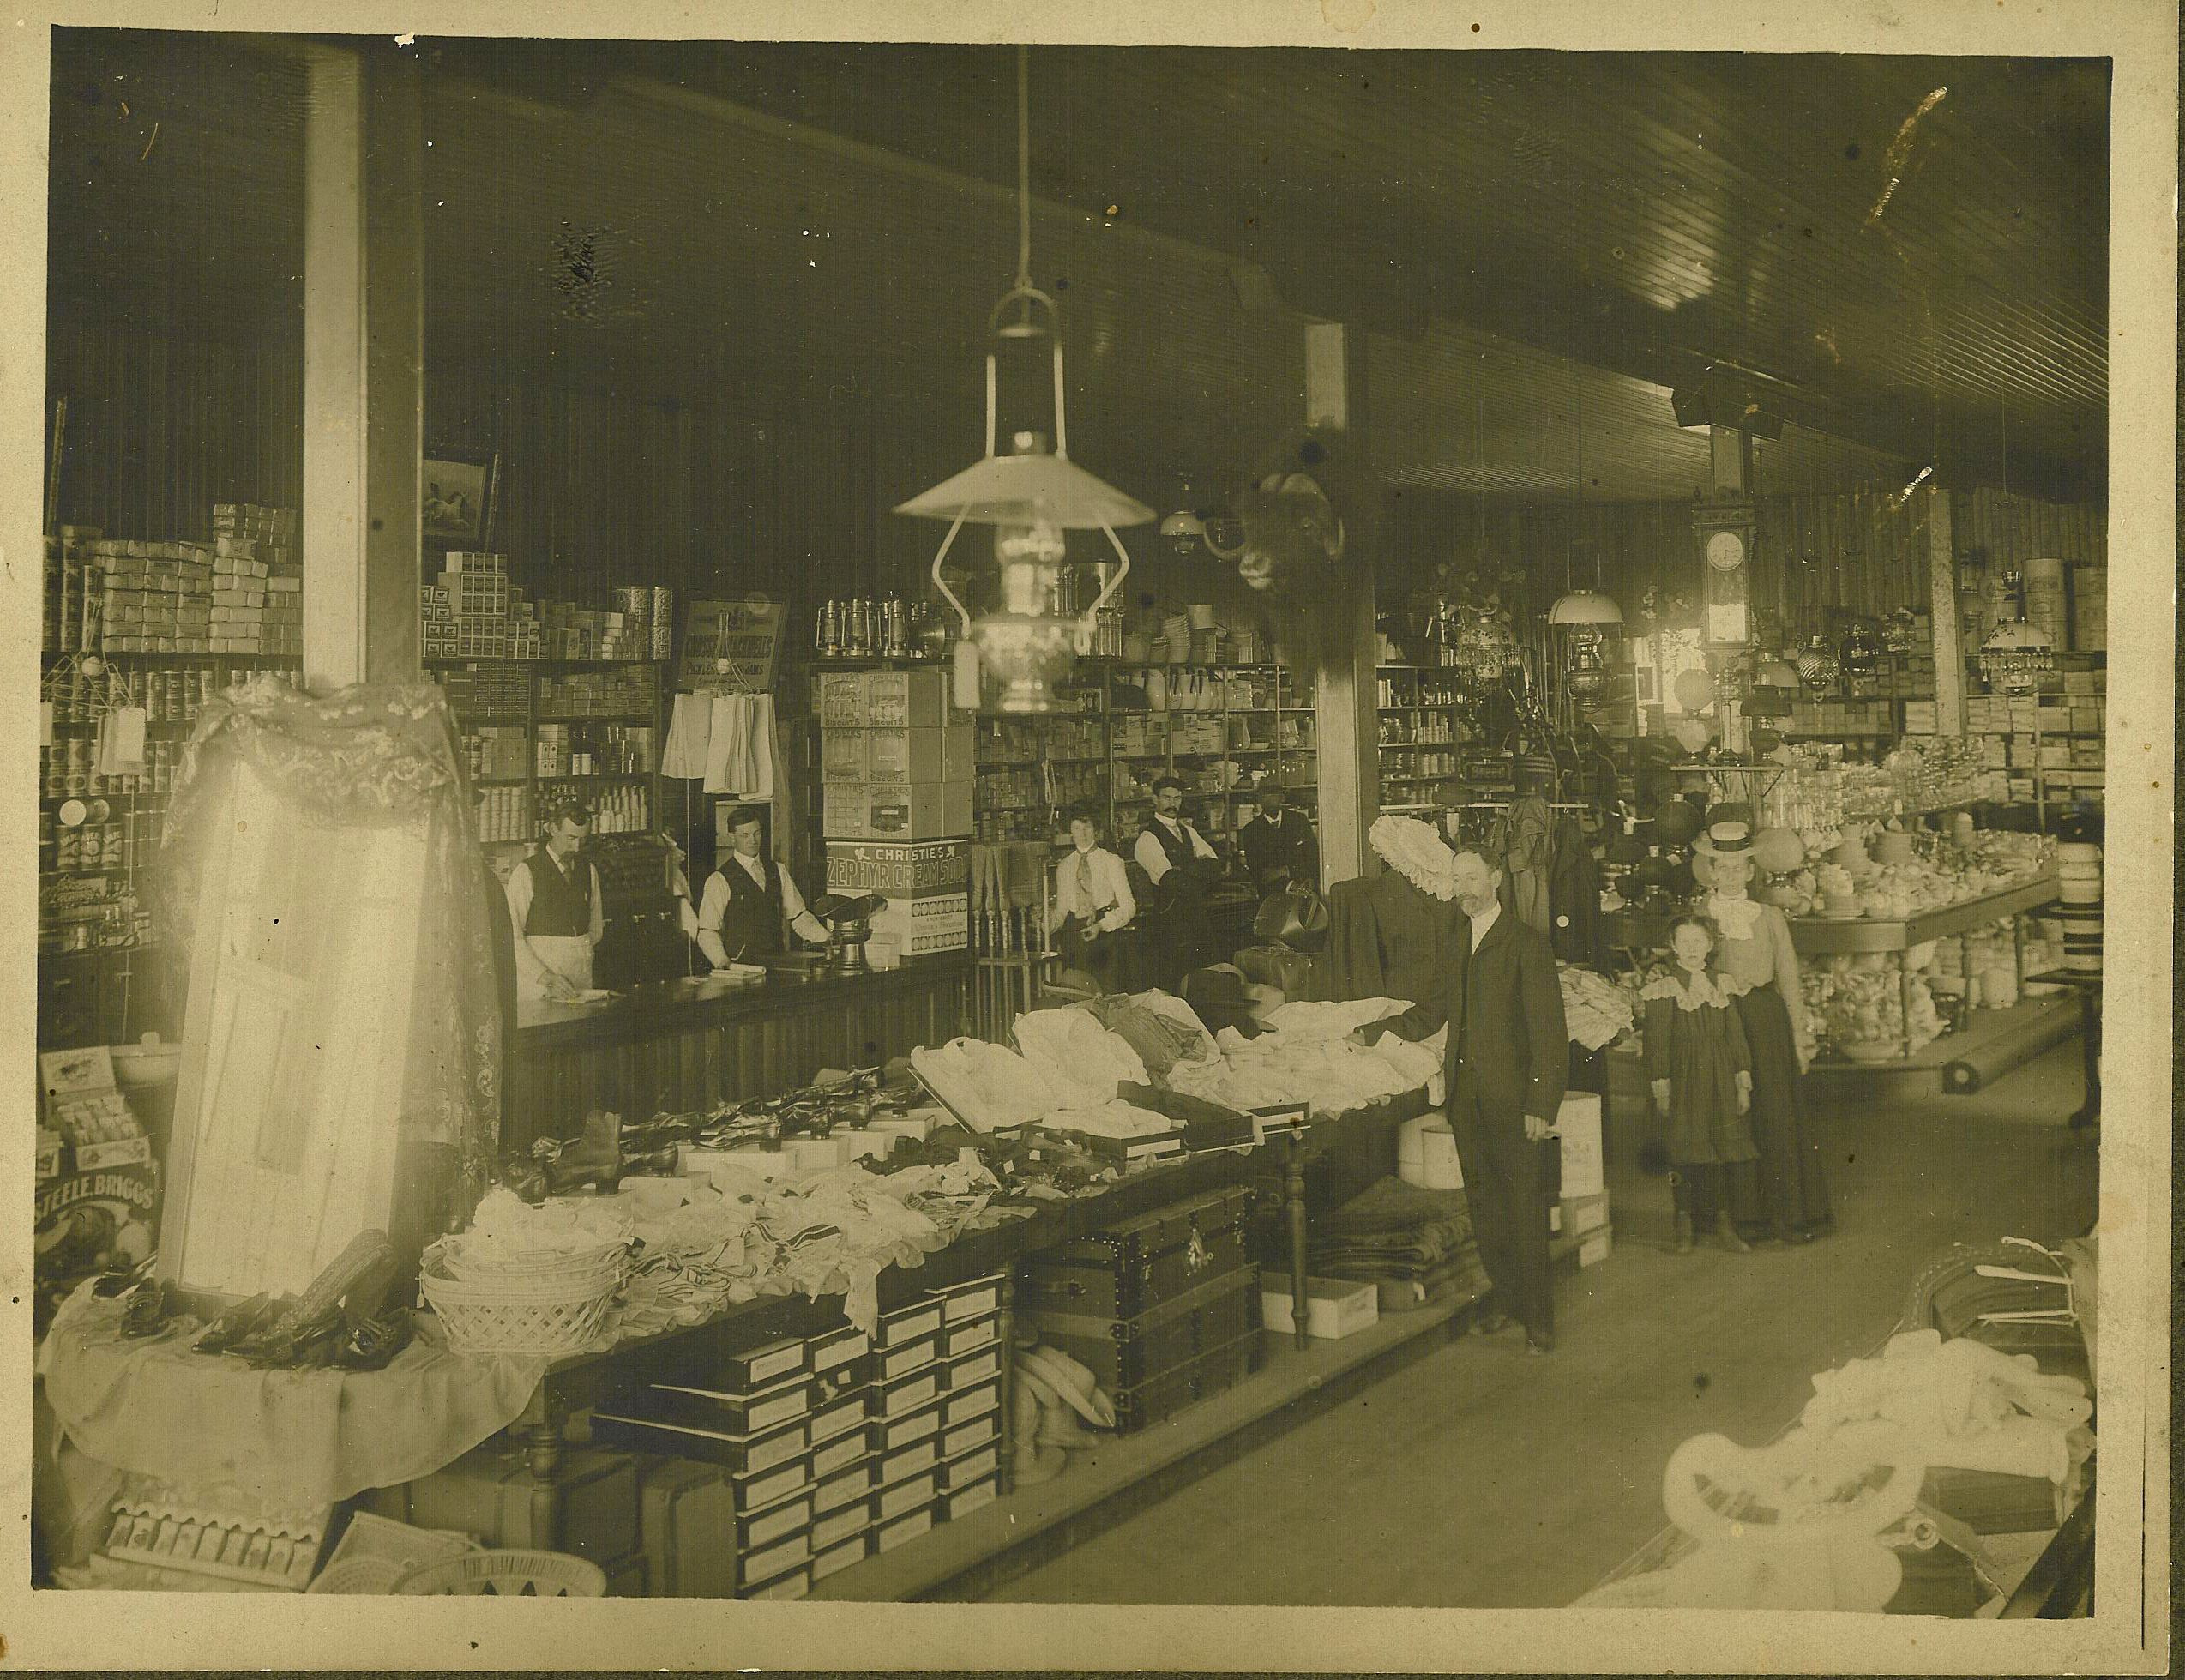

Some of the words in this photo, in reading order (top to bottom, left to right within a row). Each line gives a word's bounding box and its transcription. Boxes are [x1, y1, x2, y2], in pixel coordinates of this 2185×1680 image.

[875, 846, 944, 861] CHRISTIE'S
[827, 856, 891, 888] ZEPHYR
[892, 861, 939, 890] CREAM
[94, 1174, 153, 1210] BRIGGS
